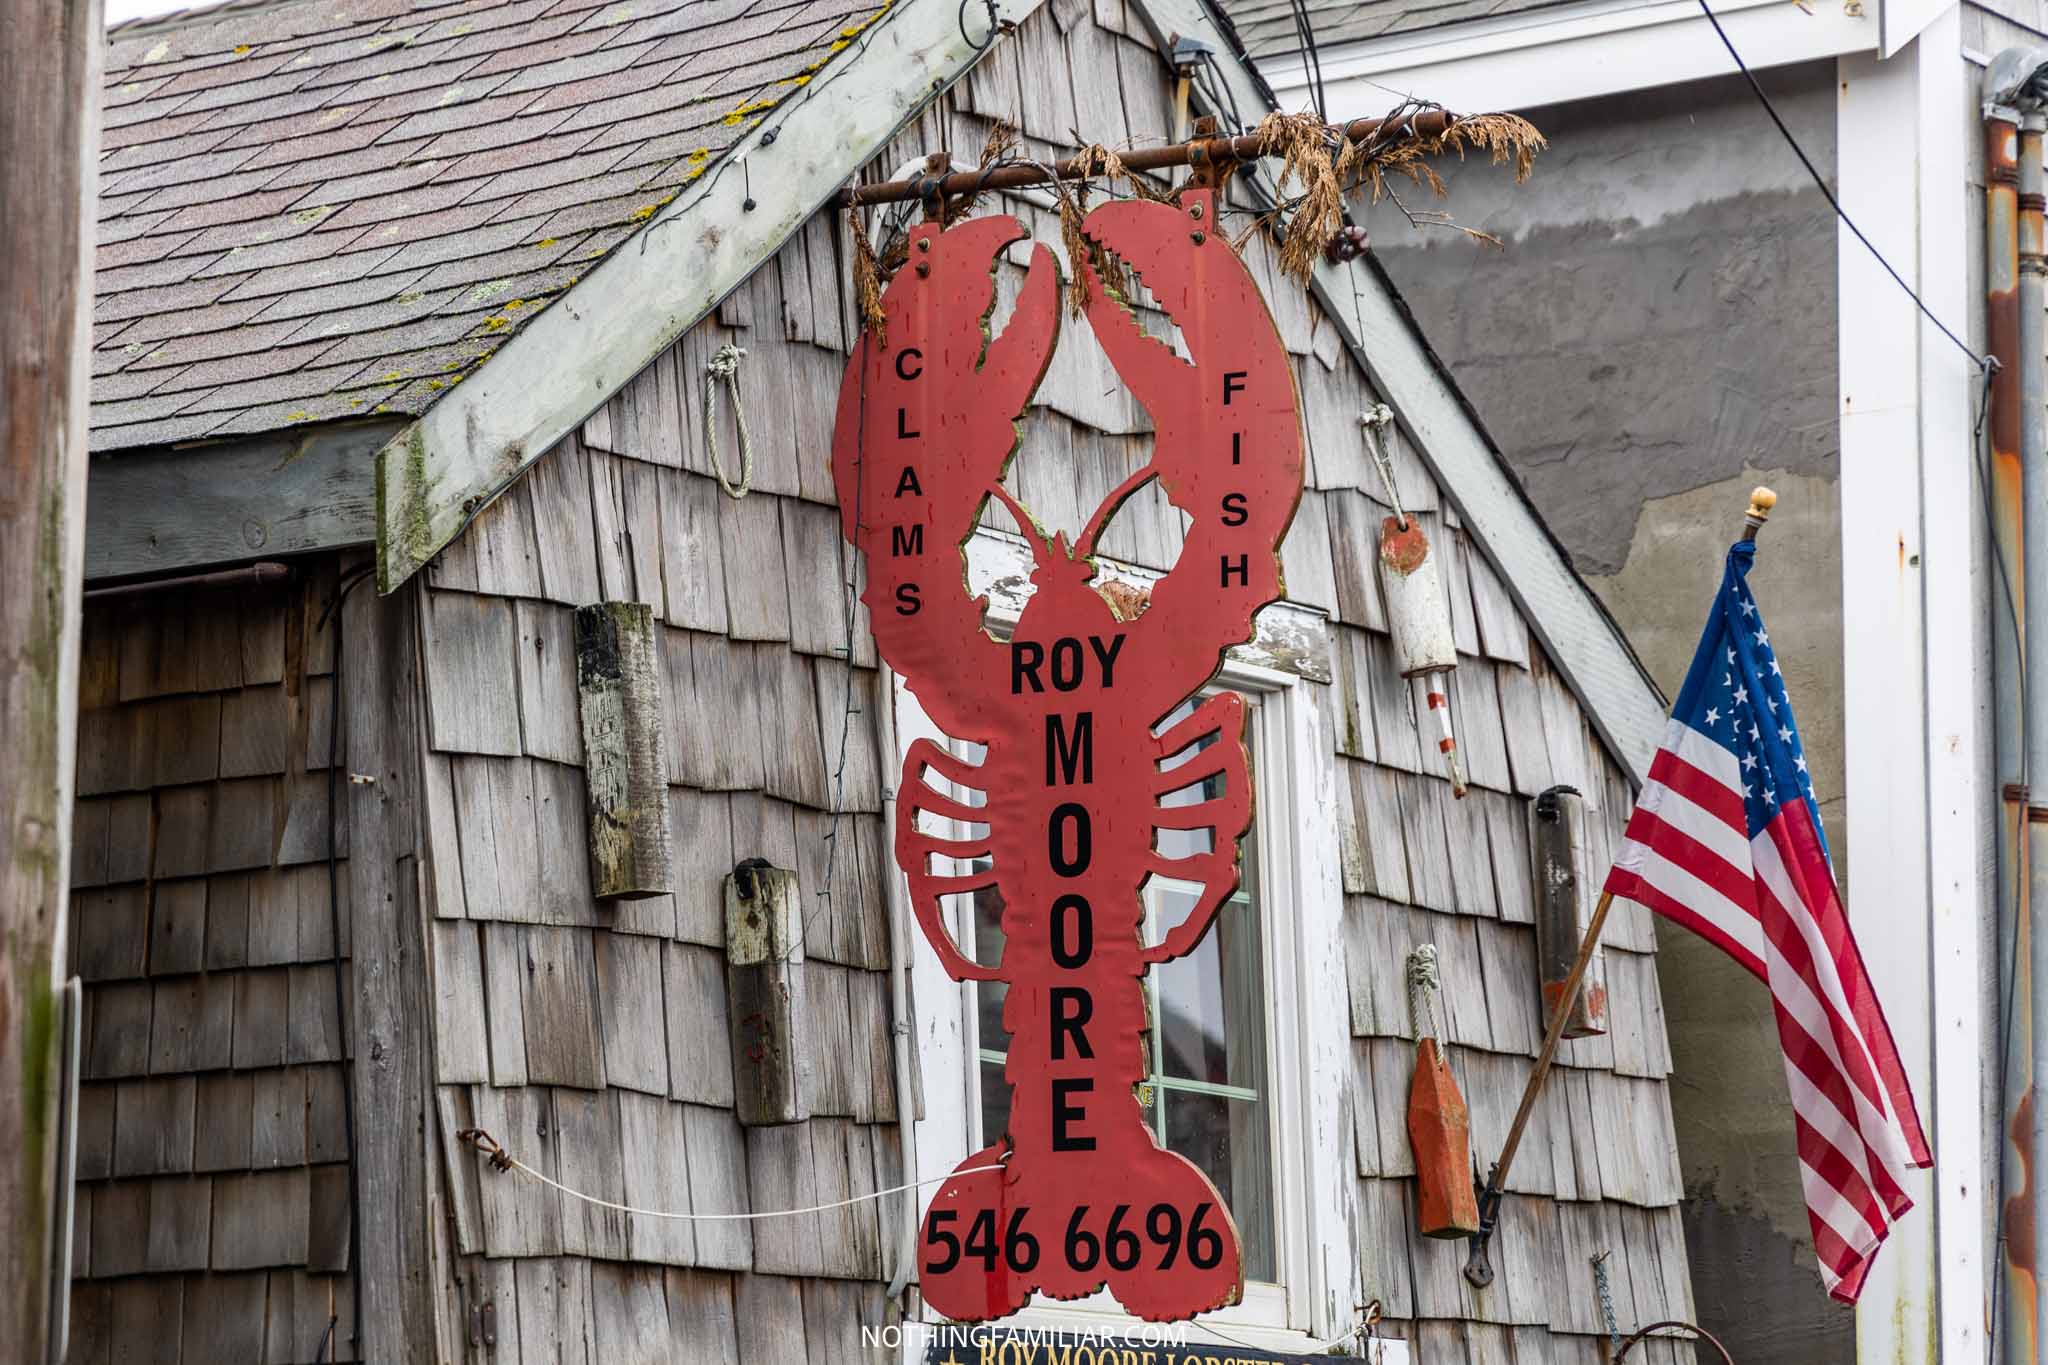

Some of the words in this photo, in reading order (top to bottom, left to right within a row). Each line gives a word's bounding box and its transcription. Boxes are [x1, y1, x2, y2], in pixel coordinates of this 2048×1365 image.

[891, 347, 924, 617] CLAMS
[1220, 371, 1249, 588] FISH
[1011, 632, 1127, 695] ROY
[1045, 711, 1097, 1153] MOORE
[925, 1207, 1041, 1275] 546
[1064, 1202, 1224, 1273] 6696
[978, 1338, 1040, 1365] ROY
